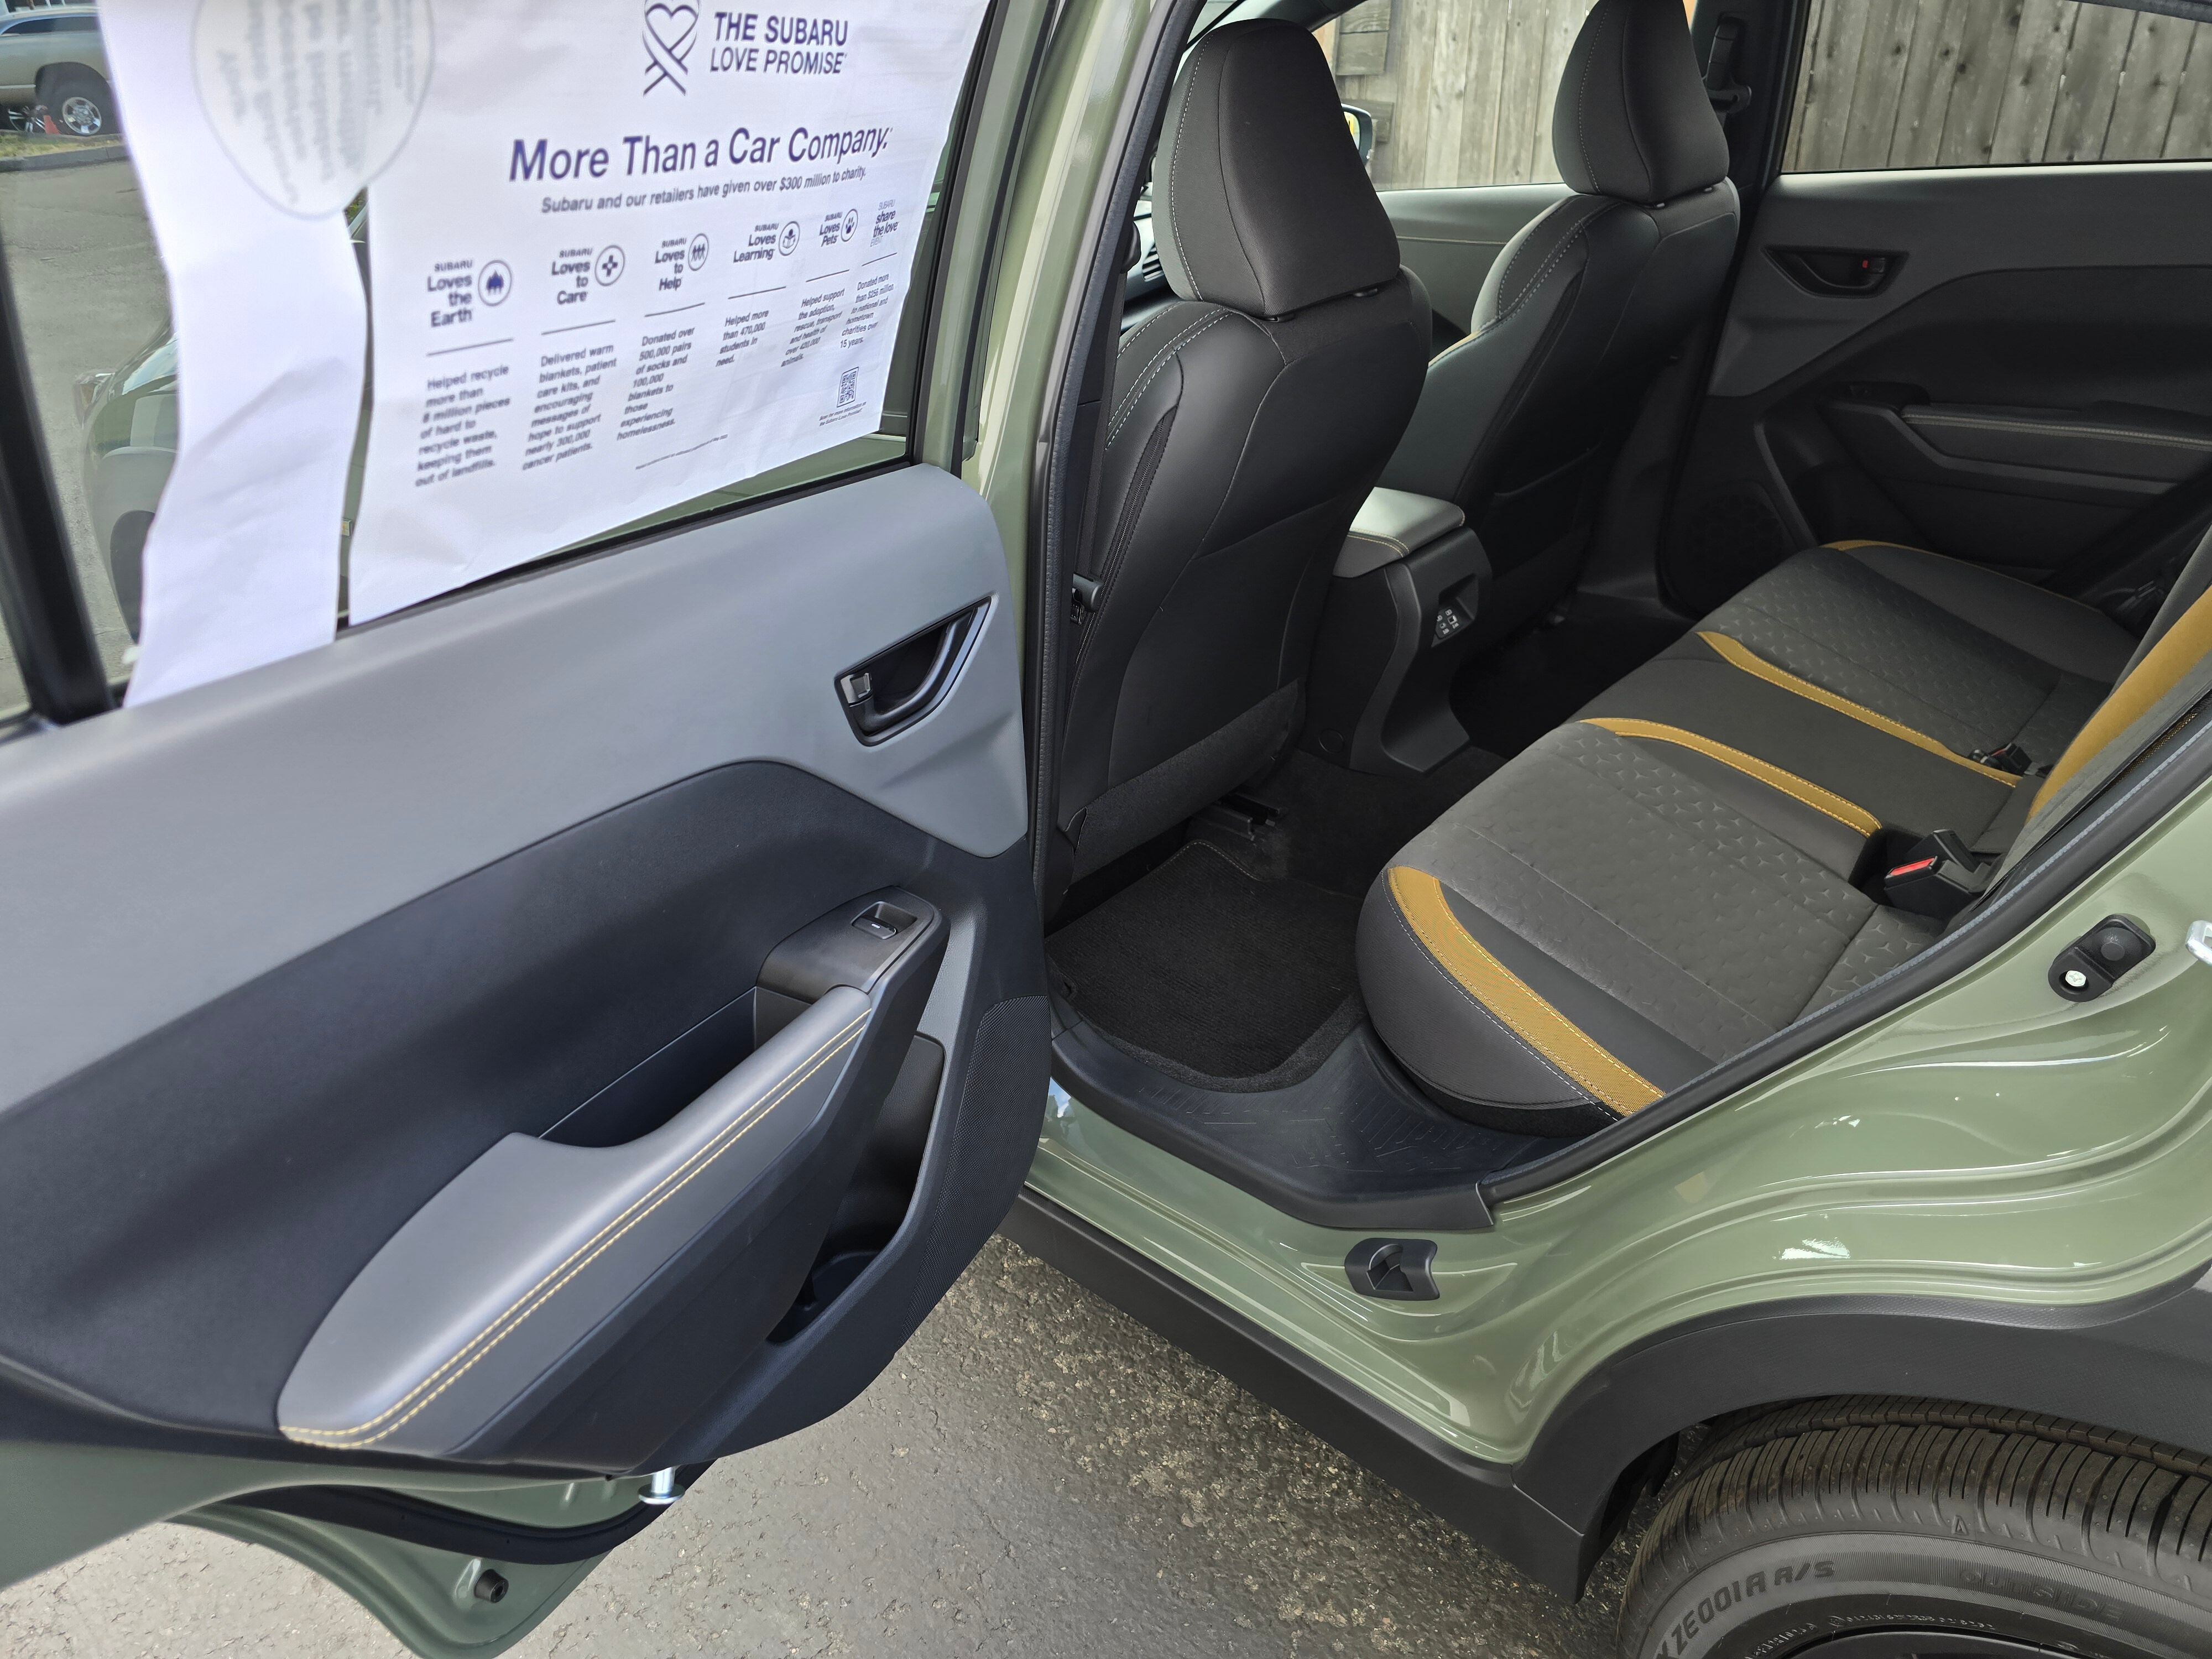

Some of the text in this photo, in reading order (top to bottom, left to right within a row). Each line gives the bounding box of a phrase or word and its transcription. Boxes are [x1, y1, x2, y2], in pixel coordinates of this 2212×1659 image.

[714, 12, 848, 46] THE SUBARU
[710, 46, 845, 75] LOVE PROMISE
[509, 127, 889, 181] More Than a Car Company.
[541, 165, 867, 213] Subaru and our retailers have given over $300 million to charity.
[878, 199, 896, 211] SUBARU
[825, 211, 843, 222] SUBARU
[876, 210, 896, 224] share
[754, 223, 779, 232] SUBARU
[818, 222, 840, 236] Loves
[873, 221, 899, 238] the love
[661, 237, 686, 248] SUBARU
[748, 234, 776, 247] Loves
[821, 234, 838, 247] Pets
[559, 248, 592, 258] SUBARU
[655, 250, 685, 264] Loves
[733, 248, 774, 264] Learning
[434, 259, 473, 272] SUBARU
[551, 261, 590, 276] Loves
[674, 262, 684, 274] to
[427, 275, 472, 292] Loves
[576, 275, 588, 288] to
[659, 276, 682, 291] Help
[857, 273, 889, 291] Donated more
[448, 291, 472, 307] the
[557, 290, 587, 305] Care
[801, 288, 846, 308] Helped support
[855, 294, 867, 304] than
[879, 284, 894, 295] million
[798, 304, 835, 320] the adoption,
[857, 299, 879, 313] national
[879, 295, 889, 306] and
[430, 307, 472, 327] Earth
[724, 310, 769, 327] Helped more
[794, 311, 843, 333] rescue, transport
[846, 312, 874, 325] hometown
[641, 327, 695, 347] Donated over
[722, 330, 739, 341] than
[789, 324, 828, 345] and health of
[841, 321, 879, 336] charities over
[639, 341, 691, 362] 500,000 pairs
[719, 336, 758, 354] students in
[785, 346, 800, 356] over
[840, 337, 864, 349] 15 years.
[540, 345, 614, 368] Delivered warm
[635, 353, 688, 375] of socks and
[715, 354, 735, 368] need.
[585, 357, 617, 376] patient
[427, 364, 509, 390] Helped recycle
[633, 373, 664, 388] 100,000
[537, 387, 559, 399] care
[582, 374, 601, 388] and
[628, 384, 674, 402] blankets to
[426, 388, 483, 408] more than
[534, 392, 593, 414] encouraging
[433, 406, 472, 421] million
[475, 398, 510, 415] pieces
[531, 403, 592, 428] messages of
[620, 408, 673, 427] experiencing
[624, 403, 648, 415] those
[420, 419, 476, 439] of hard to
[528, 413, 602, 442] hope to support
[617, 418, 675, 441] homelessness.
[419, 438, 460, 456] recycle
[525, 441, 555, 457] nearly
[418, 445, 492, 471] keeping them
[523, 442, 592, 471] cancer patients.
[415, 473, 435, 487] out
[437, 468, 450, 481] of
[1773, 1561, 1835, 1587] A/S
